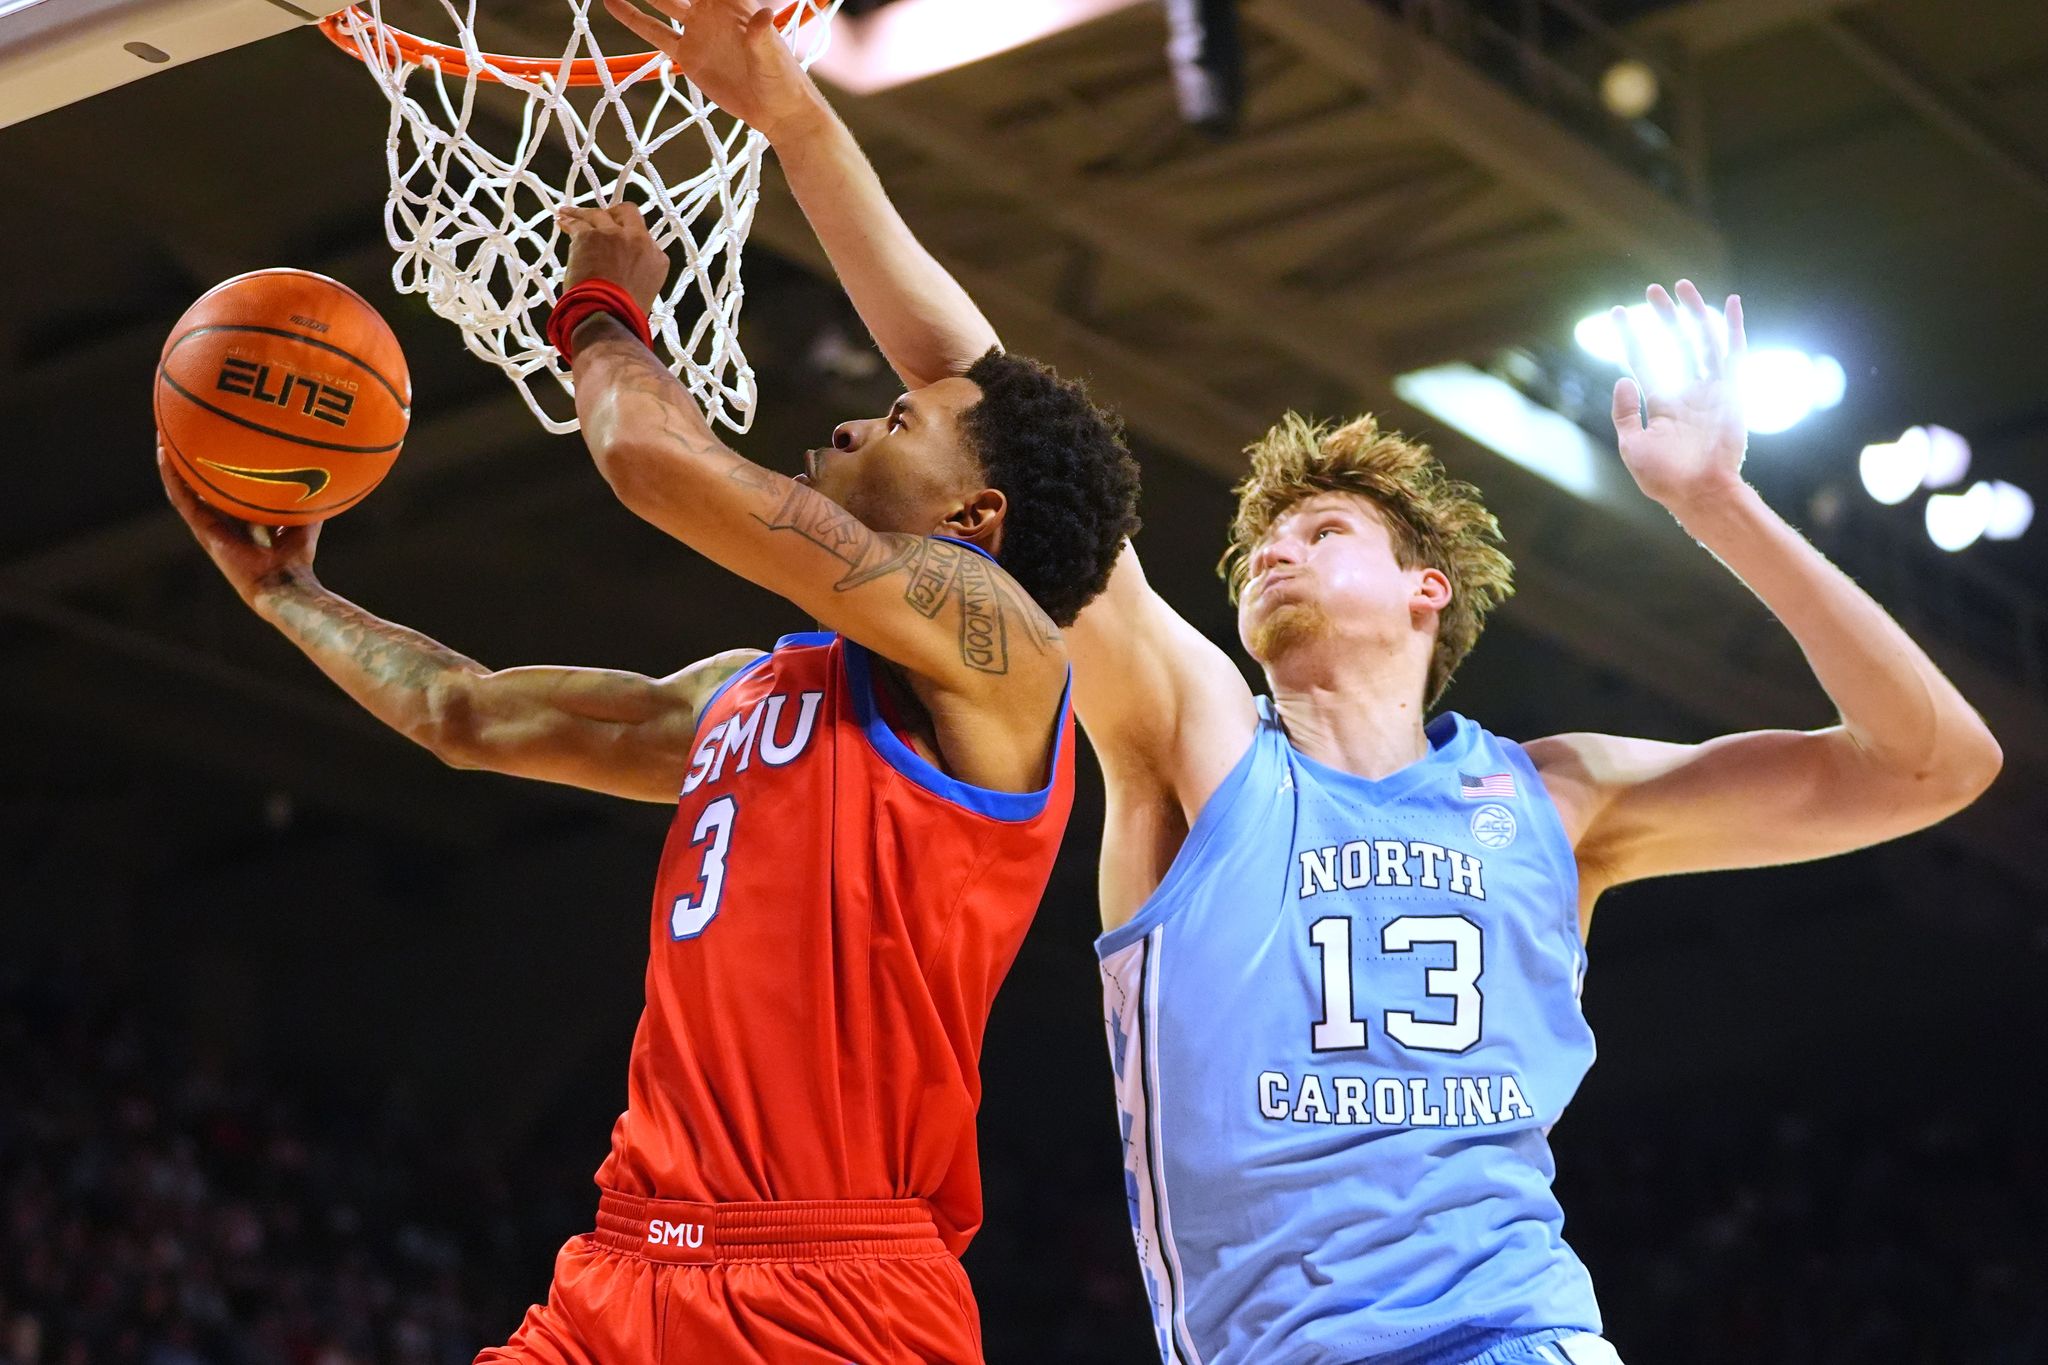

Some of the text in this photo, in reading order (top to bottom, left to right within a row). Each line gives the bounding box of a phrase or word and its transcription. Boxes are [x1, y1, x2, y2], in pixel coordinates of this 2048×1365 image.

[215, 357, 356, 429] ELITE
[679, 691, 825, 796] SMU
[669, 793, 739, 941] 3
[1299, 839, 1486, 900] NORTH
[1309, 915, 1484, 1053] 13
[1257, 1070, 1534, 1127] CAROLINA
[648, 1219, 704, 1248] SMU
